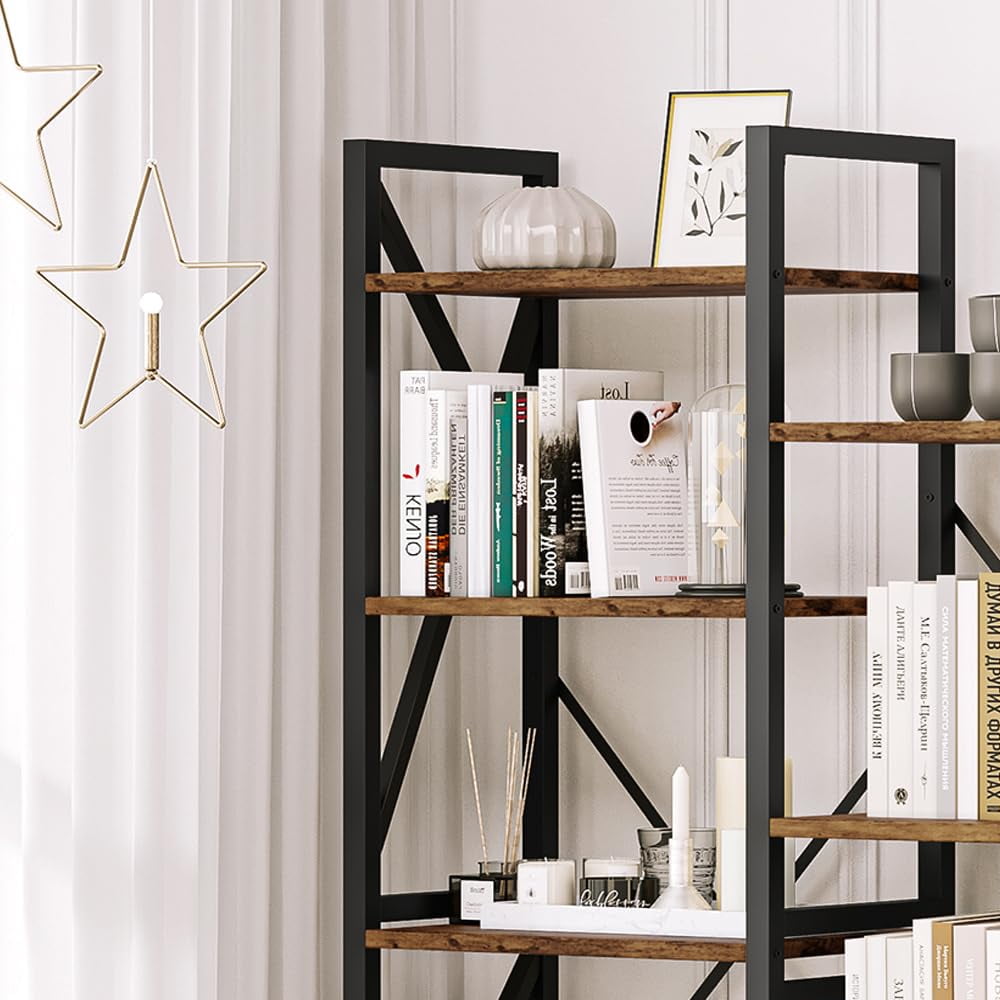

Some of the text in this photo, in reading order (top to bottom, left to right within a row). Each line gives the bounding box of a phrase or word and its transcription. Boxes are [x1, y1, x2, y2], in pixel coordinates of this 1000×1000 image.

[895, 606, 906, 701] ДАНТЕ АЛИГЬЕРИ
[987, 641, 1000, 650] В
[872, 651, 882, 688] МИРУ
[985, 655, 1000, 714] ДРУГИХ
[917, 642, 931, 752] Салтыков-Щедрин
[872, 751, 882, 759] К
[986, 805, 1000, 813] II
